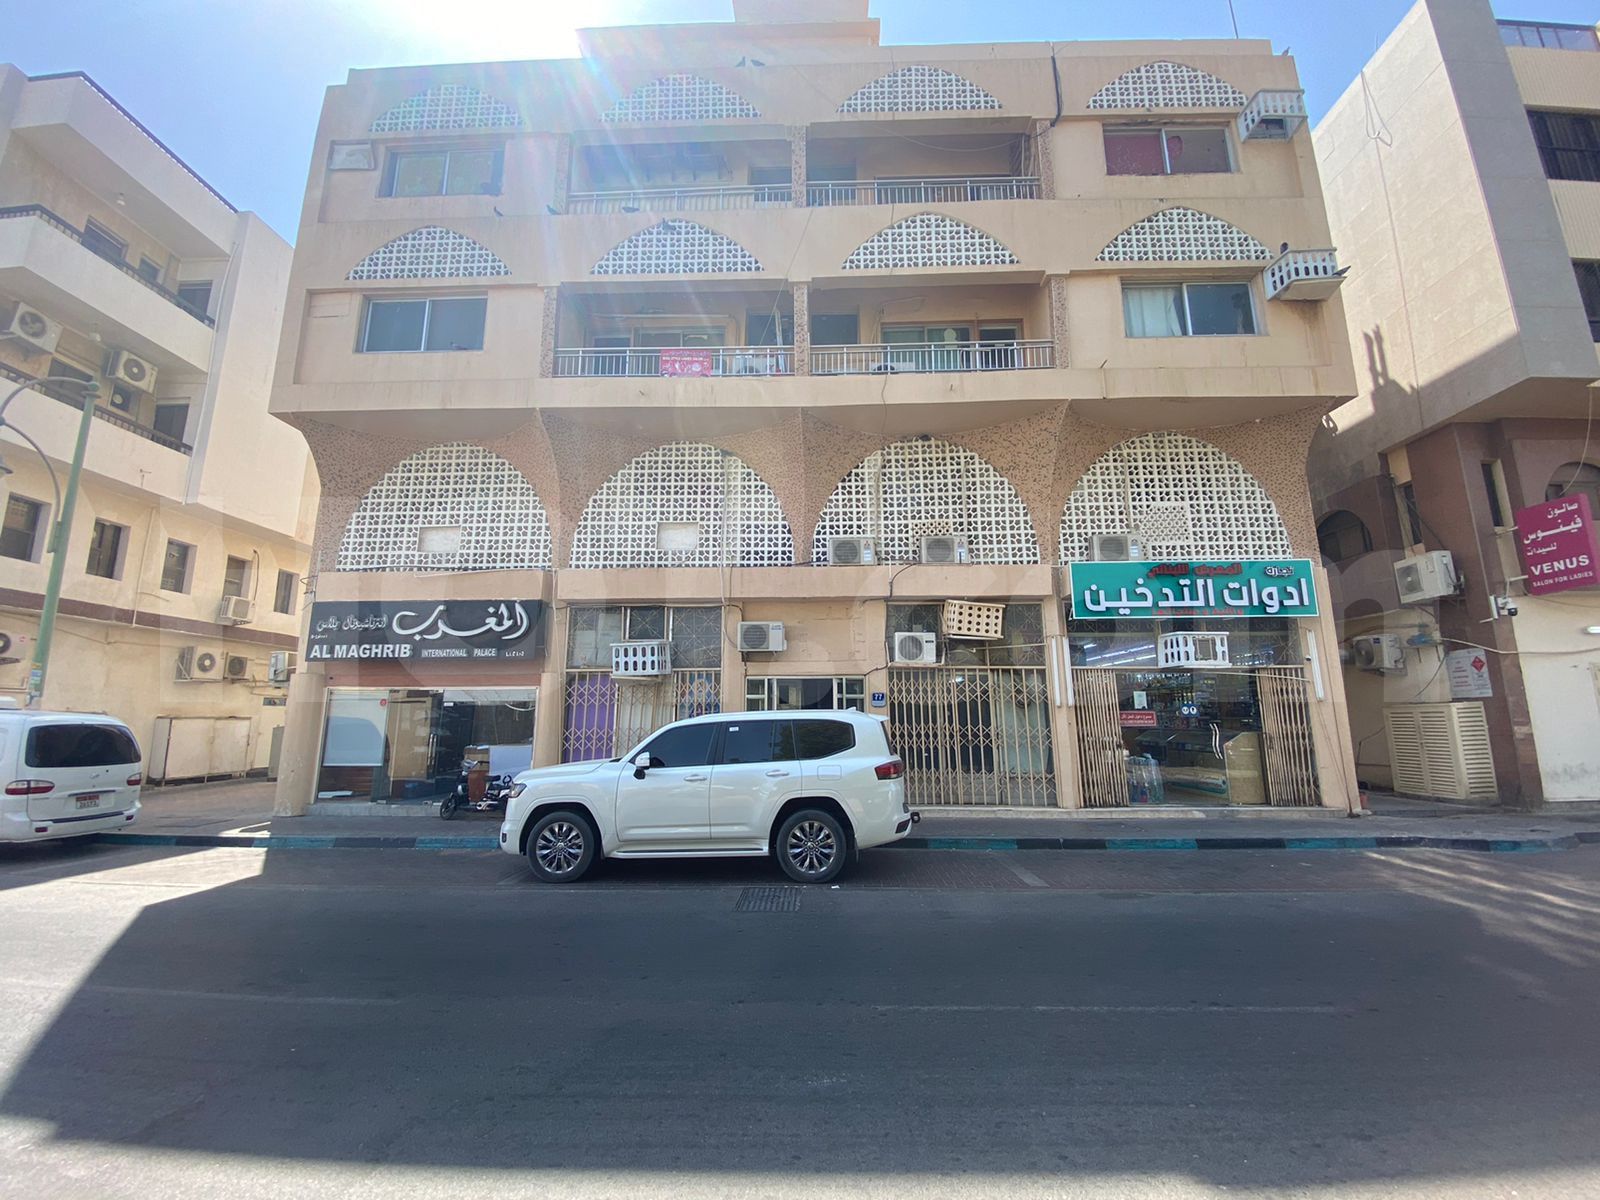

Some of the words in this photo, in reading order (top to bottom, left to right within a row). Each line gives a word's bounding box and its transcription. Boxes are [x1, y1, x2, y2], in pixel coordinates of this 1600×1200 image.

[1547, 502, 1579, 519] صالون
[1523, 514, 1583, 544] فينوس
[1526, 542, 1557, 556] للسيدات
[1530, 554, 1590, 576] VENUS
[1533, 578, 1554, 587] SALON
[1554, 575, 1568, 583] FOR
[1569, 571, 1593, 580] LADIES
[1084, 578, 1215, 615] التدخين
[1222, 578, 1310, 614] ادوات
[392, 601, 530, 641] المغرب
[310, 643, 331, 659] AL
[333, 642, 413, 658] MAGHRIB
[421, 647, 468, 658] INTERNATIONAL
[473, 647, 497, 657] PALACE
